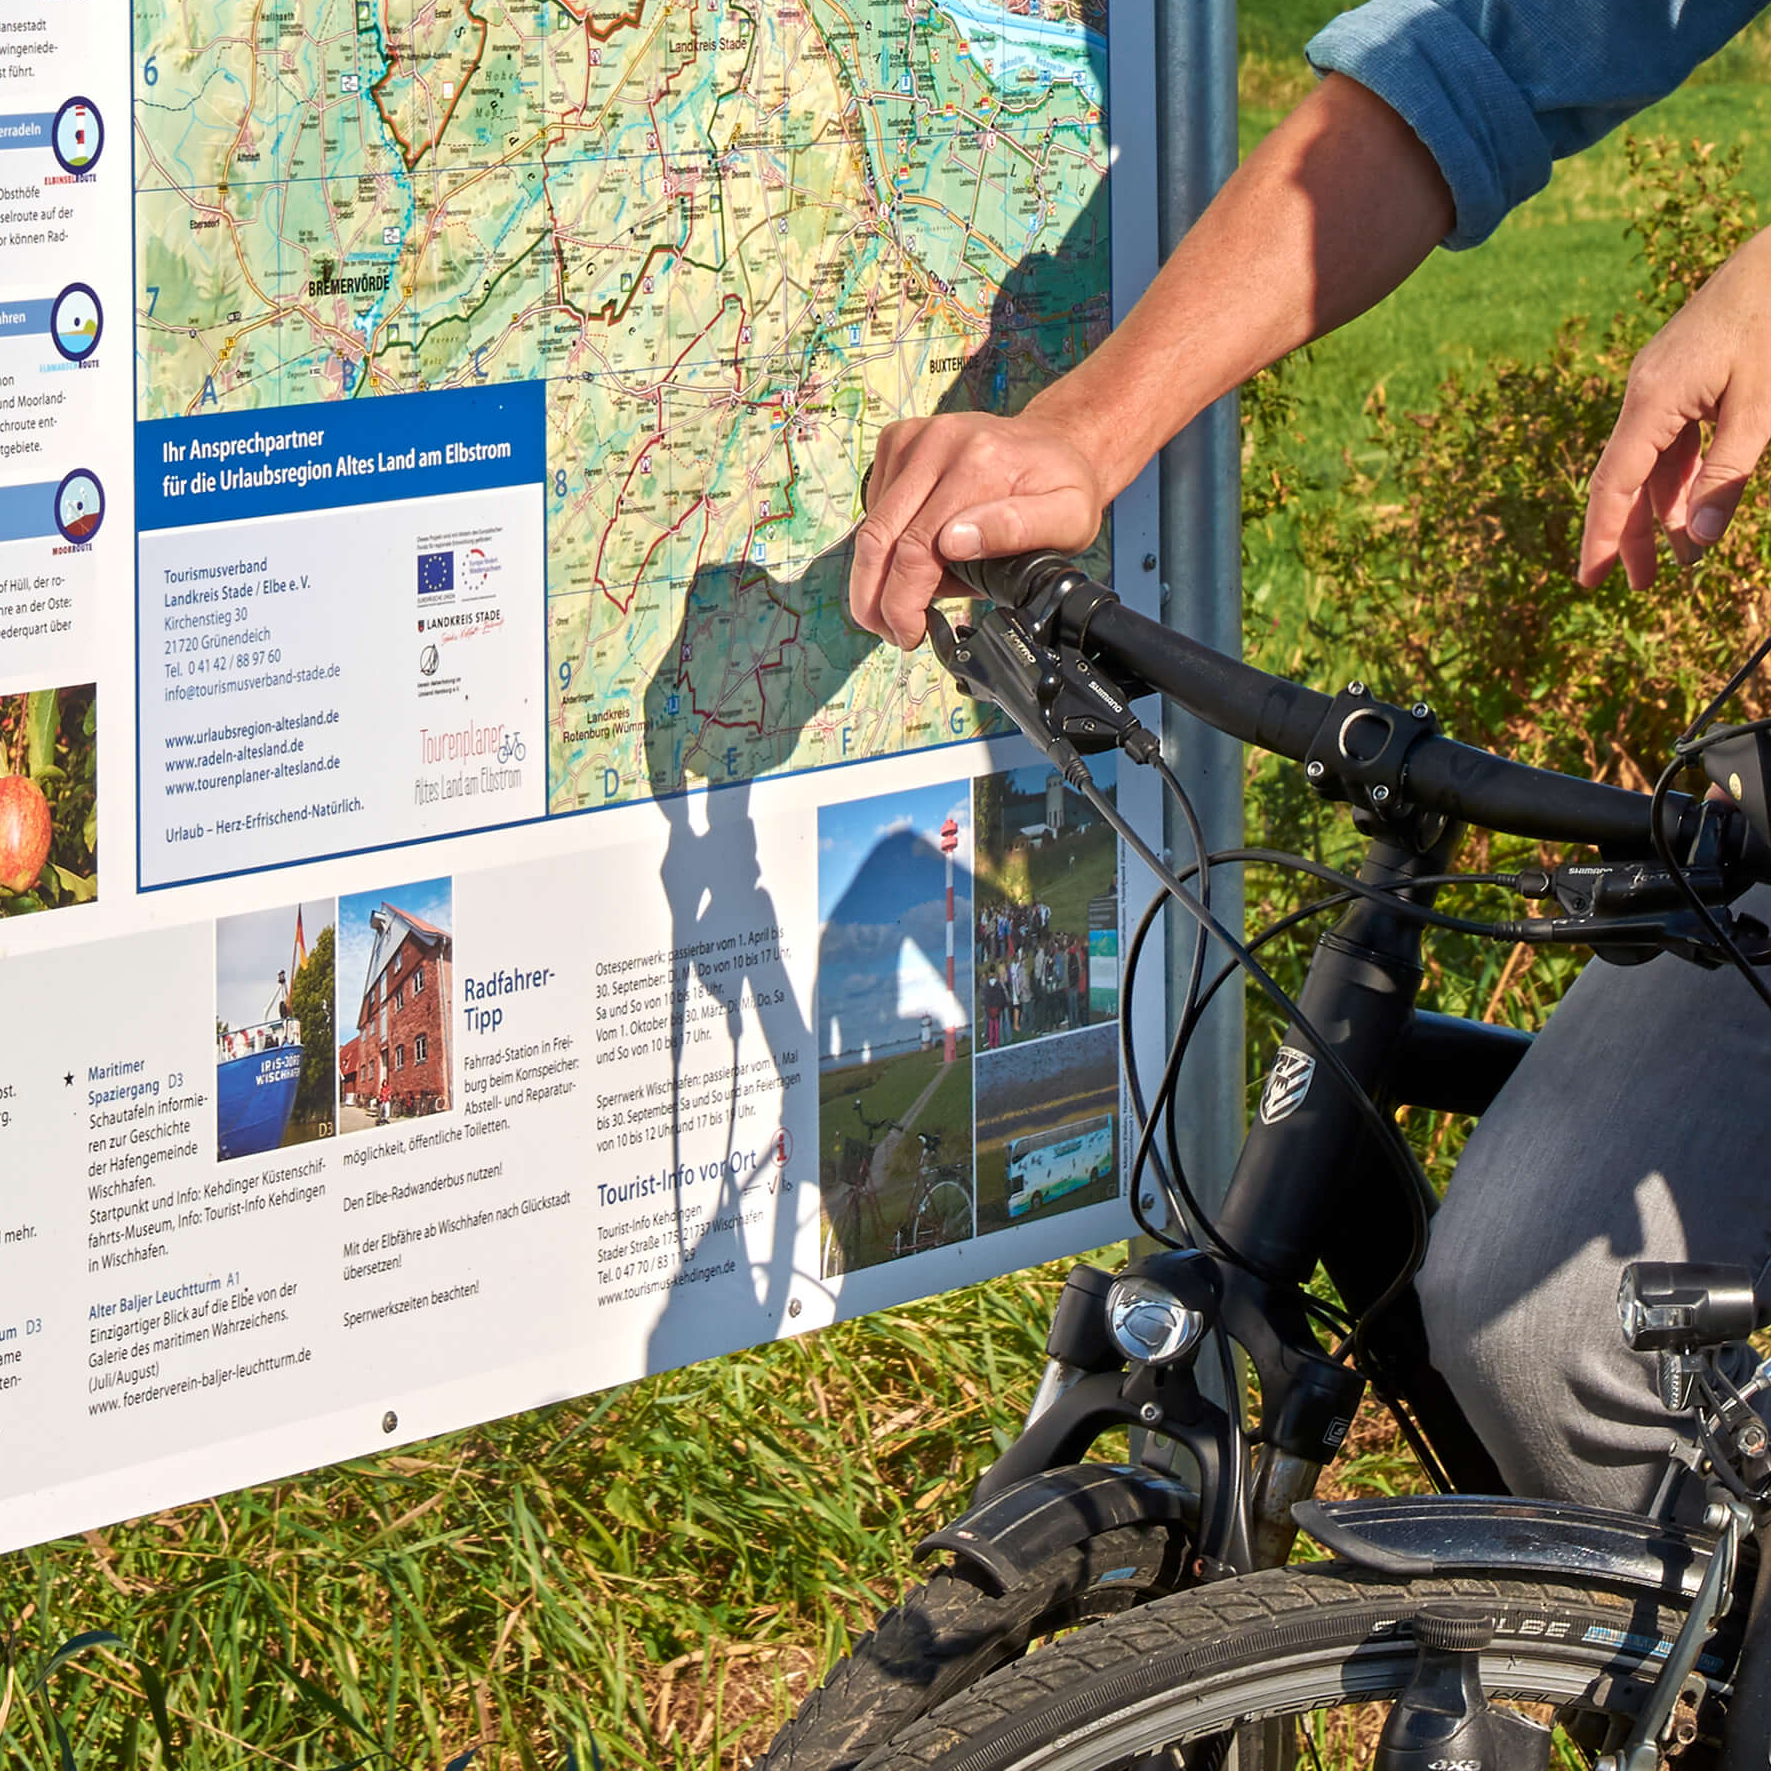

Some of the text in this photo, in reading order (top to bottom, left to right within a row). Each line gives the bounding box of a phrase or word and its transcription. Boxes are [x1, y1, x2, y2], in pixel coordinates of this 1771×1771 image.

[669, 36, 747, 54] Landkreis Stade
[308, 274, 390, 297] BREMERVÖRDE
[163, 430, 325, 463] Ihr Ansprechpartner
[162, 441, 511, 497] für die Urlaubsregion Altes Land am Elbstrom
[555, 468, 568, 498] 8
[163, 556, 268, 584] Tourismusverband
[427, 609, 501, 630] LANDKREIS STADE
[164, 626, 271, 656] 21720 Grünendeich
[164, 663, 341, 702] info@tourismusverband-stade.de
[1088, 680, 1123, 714] SHIMANO
[164, 709, 340, 749] www.urlaubsregion-altesland.de
[165, 737, 304, 773] www.radeln-altesland.de
[165, 755, 341, 796] www.tourenplaner-altesland.de
[464, 967, 555, 1003] Radfahrer-
[463, 1006, 503, 1035] Tipp
[87, 1059, 145, 1082] Maritimer
[87, 1072, 184, 1108] Spaziergang D3
[597, 1150, 758, 1208] Tourist-Info vor Ort
[88, 1271, 239, 1321] Alter Baljer Leuchtturm A1
[597, 1259, 736, 1307] www.tourismus-kehdingen.de
[26, 1318, 42, 1336] D3
